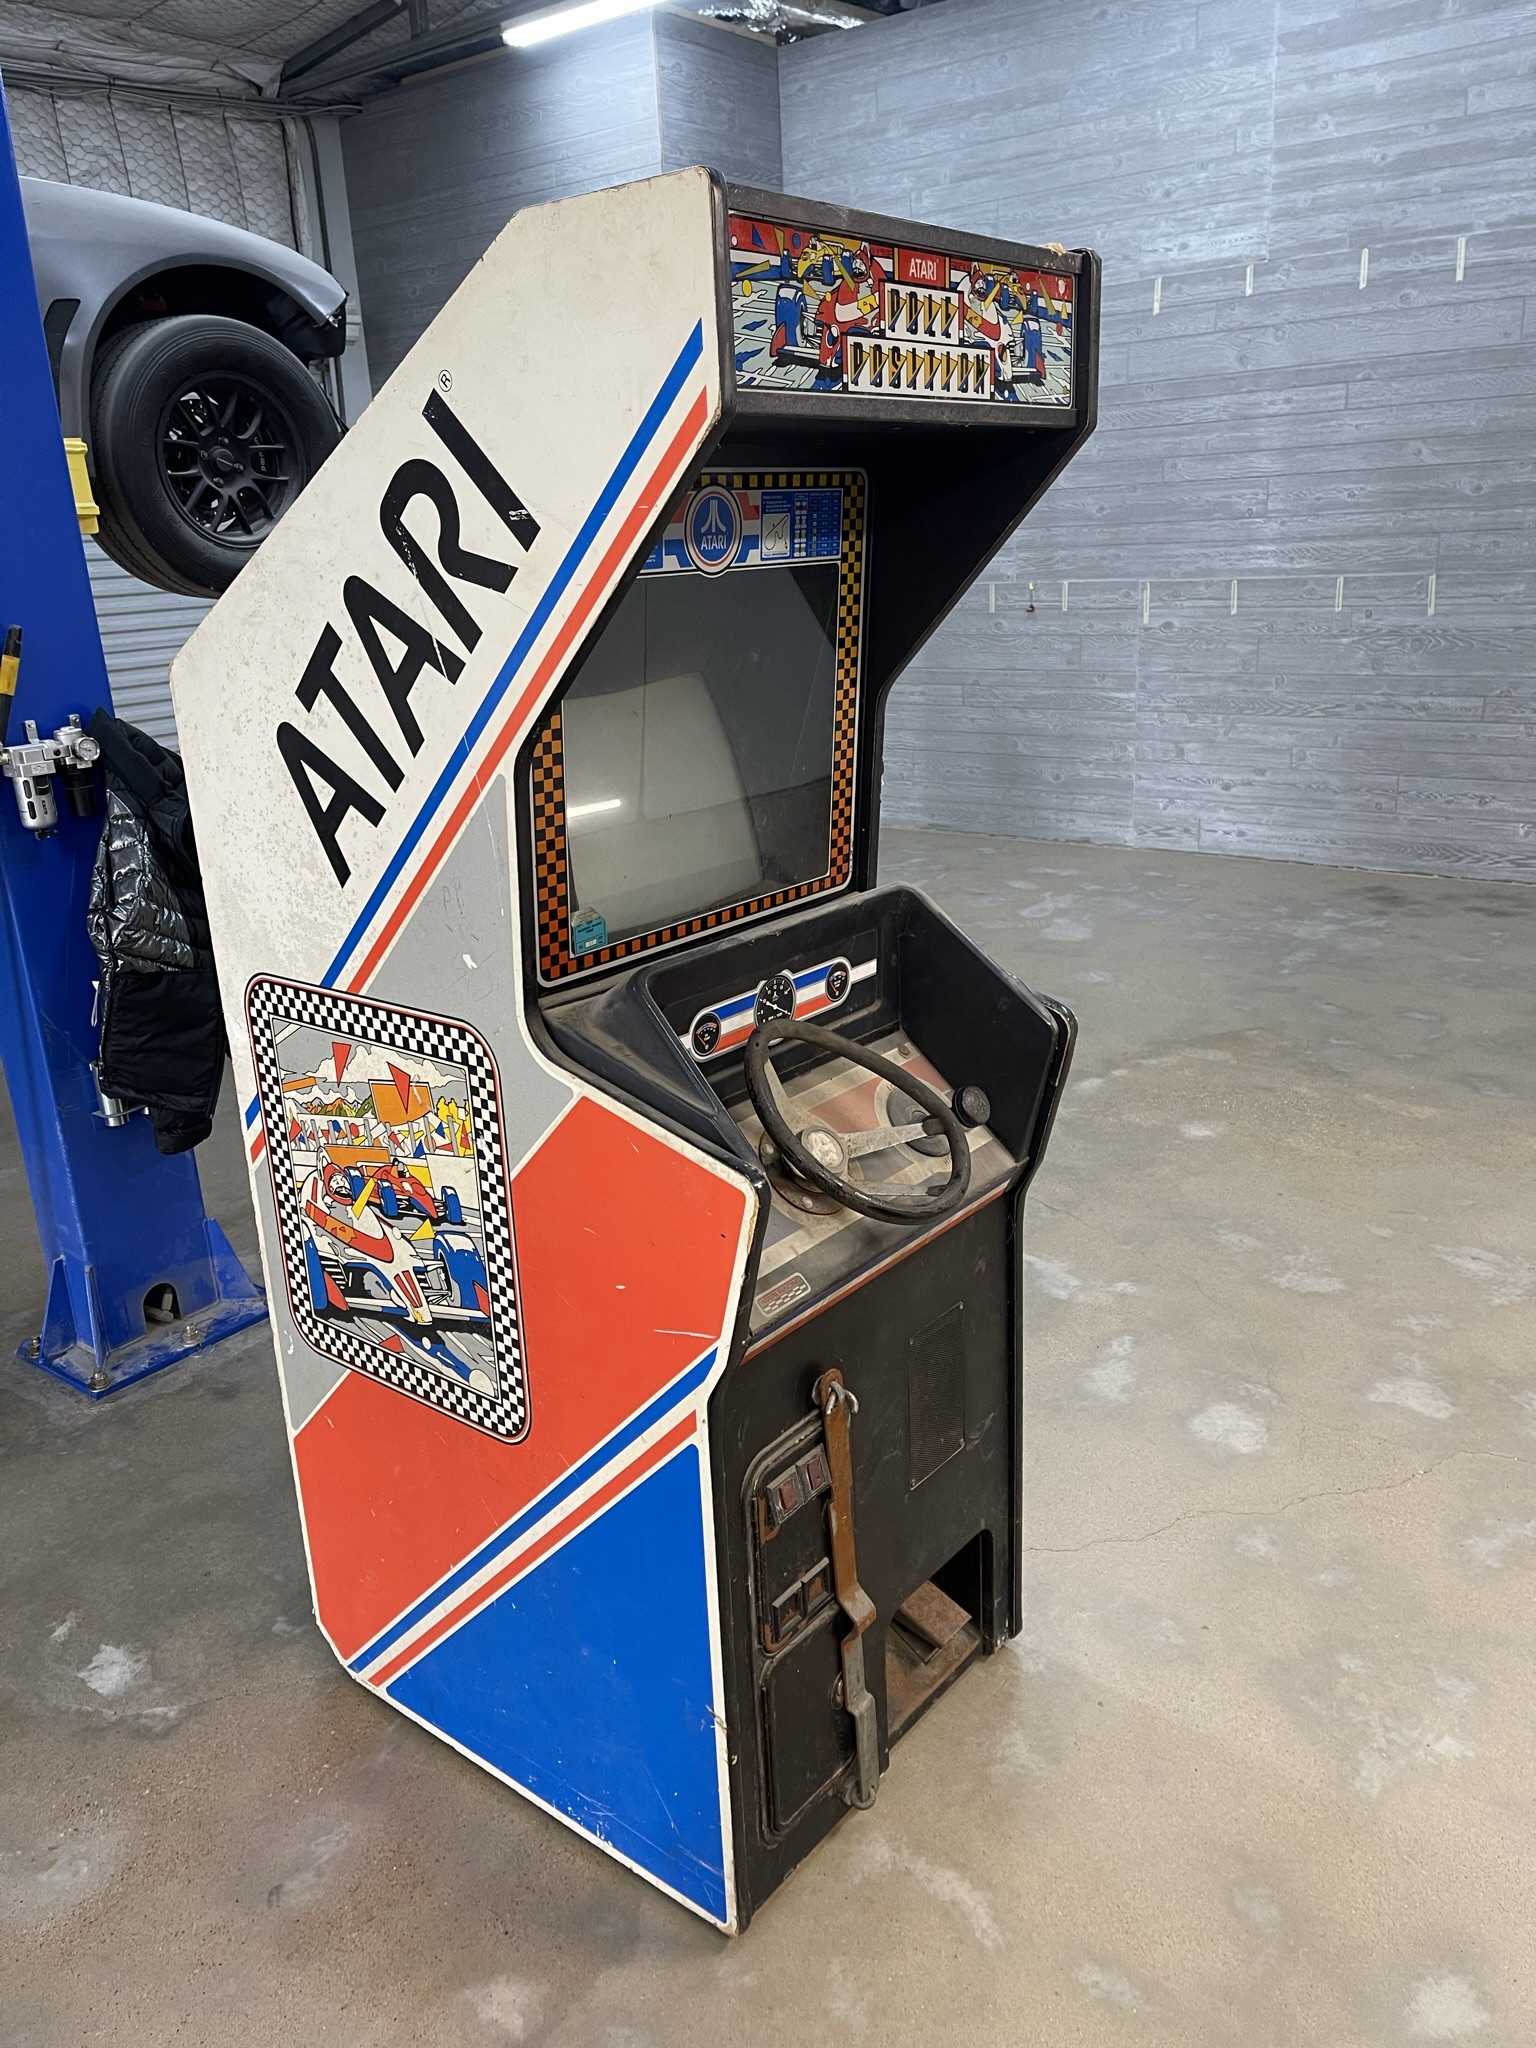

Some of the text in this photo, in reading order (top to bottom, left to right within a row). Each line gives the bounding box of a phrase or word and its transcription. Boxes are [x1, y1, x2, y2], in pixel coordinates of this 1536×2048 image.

[909, 257, 937, 281] ATARI
[887, 288, 959, 339] POLE
[849, 341, 990, 395] POSITION
[700, 534, 728, 551] ATARI
[276, 387, 542, 889] ATARI
